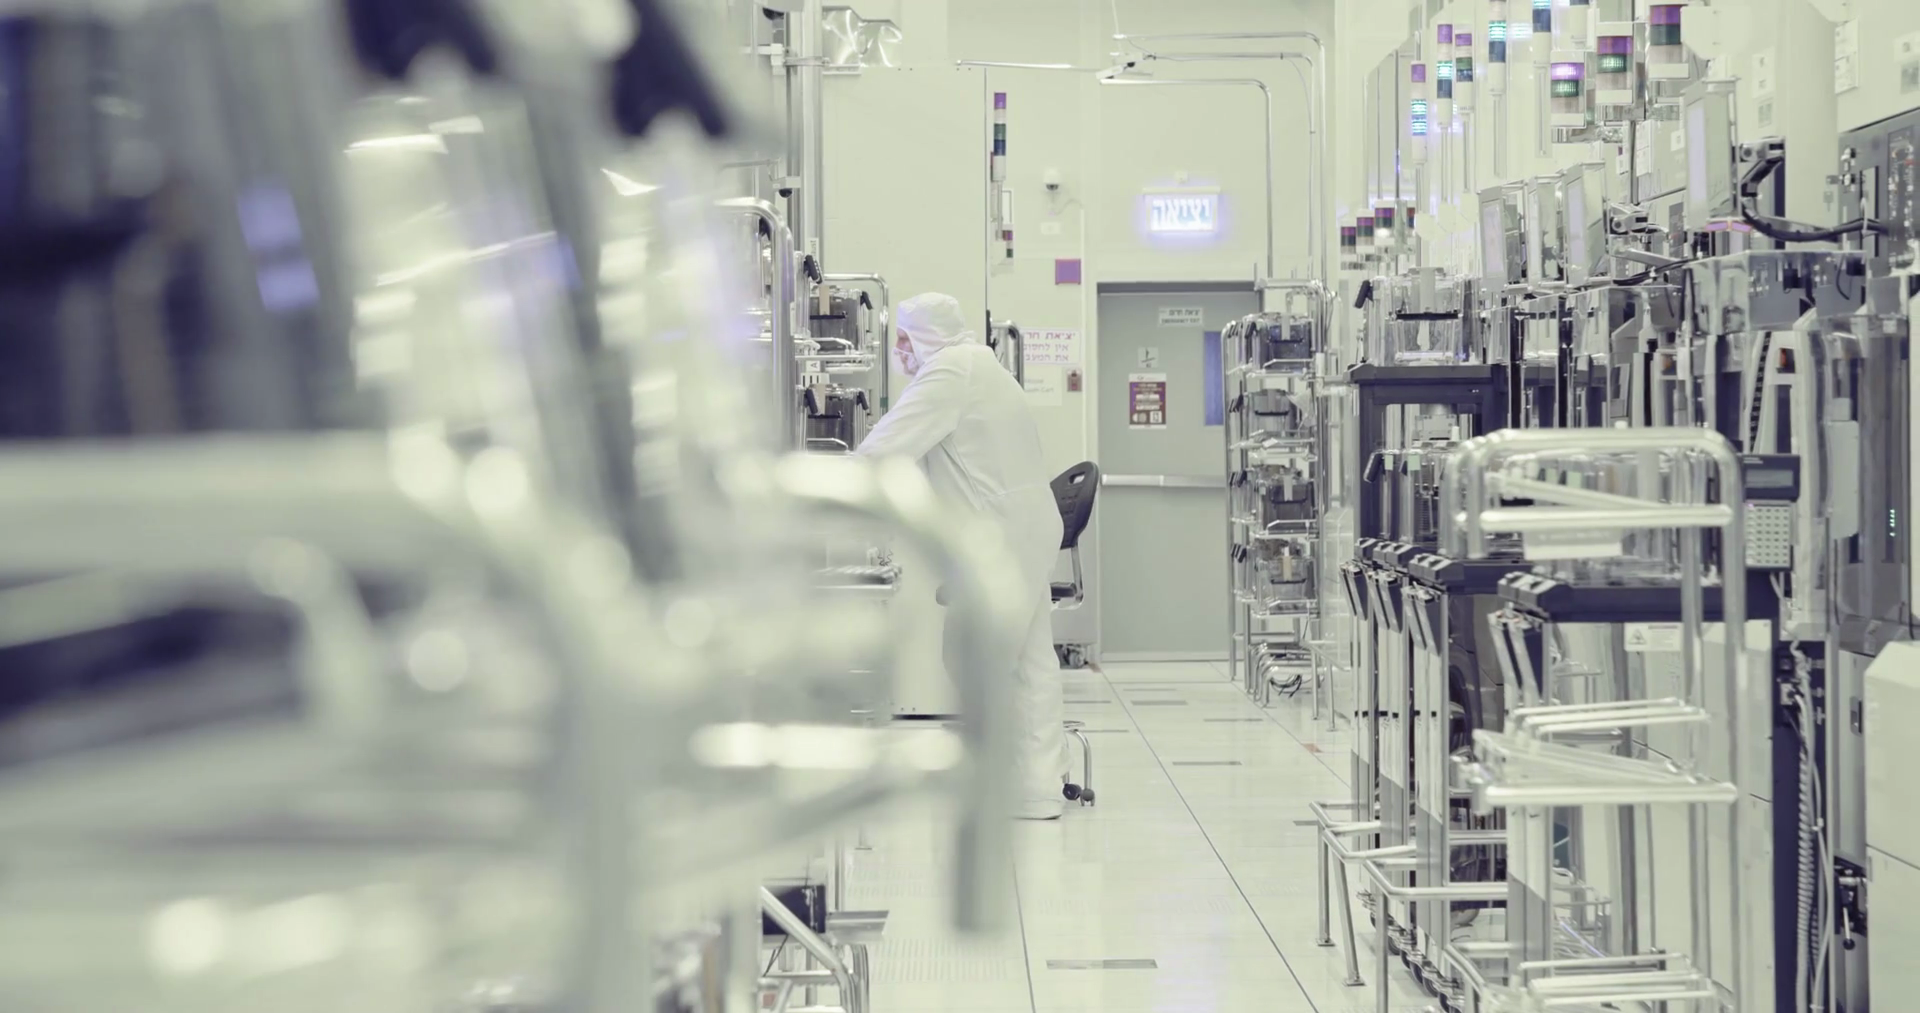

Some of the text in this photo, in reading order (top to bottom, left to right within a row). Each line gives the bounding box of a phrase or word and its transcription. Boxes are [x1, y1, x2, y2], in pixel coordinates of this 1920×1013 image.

[1151, 198, 1211, 227] יציאה
[1026, 331, 1076, 340] יציאת חר
[1055, 343, 1069, 352] אין
